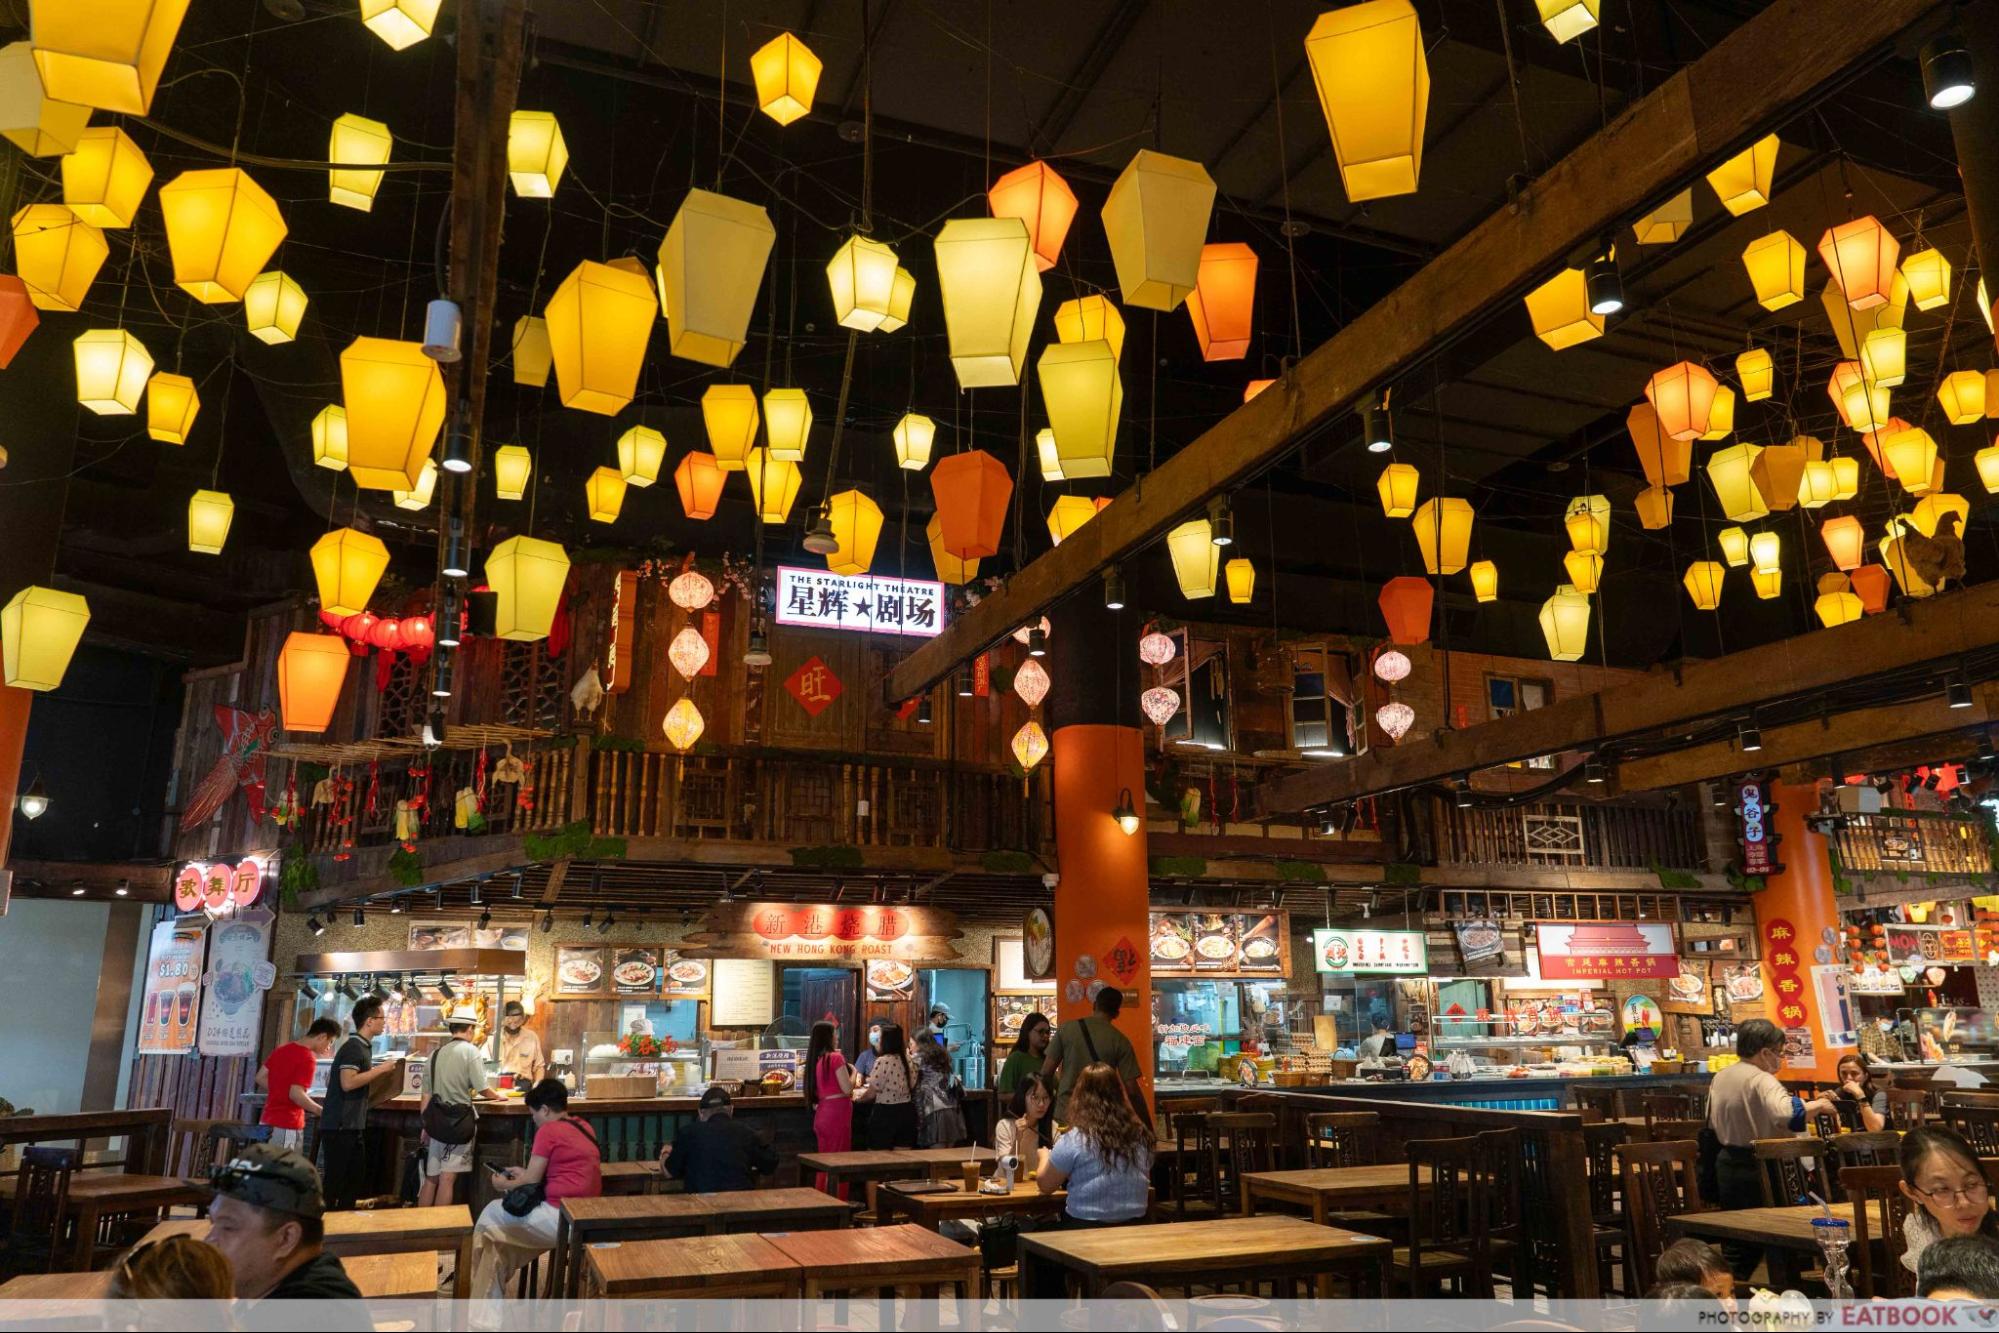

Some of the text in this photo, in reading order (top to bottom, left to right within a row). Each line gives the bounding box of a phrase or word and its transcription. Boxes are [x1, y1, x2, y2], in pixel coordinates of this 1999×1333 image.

[789, 575, 934, 596] THE STARLIGHT THEATRE
[800, 666, 831, 701] 旺
[179, 872, 255, 899] 歌舞厅
[766, 913, 897, 935] 新港烧腊
[770, 944, 893, 954] NEW HONG KONG ROAST
[159, 962, 188, 977] $1.80
[1572, 967, 1612, 975] IMPERIAL
[1771, 927, 1802, 1019] 麻辣香锅
